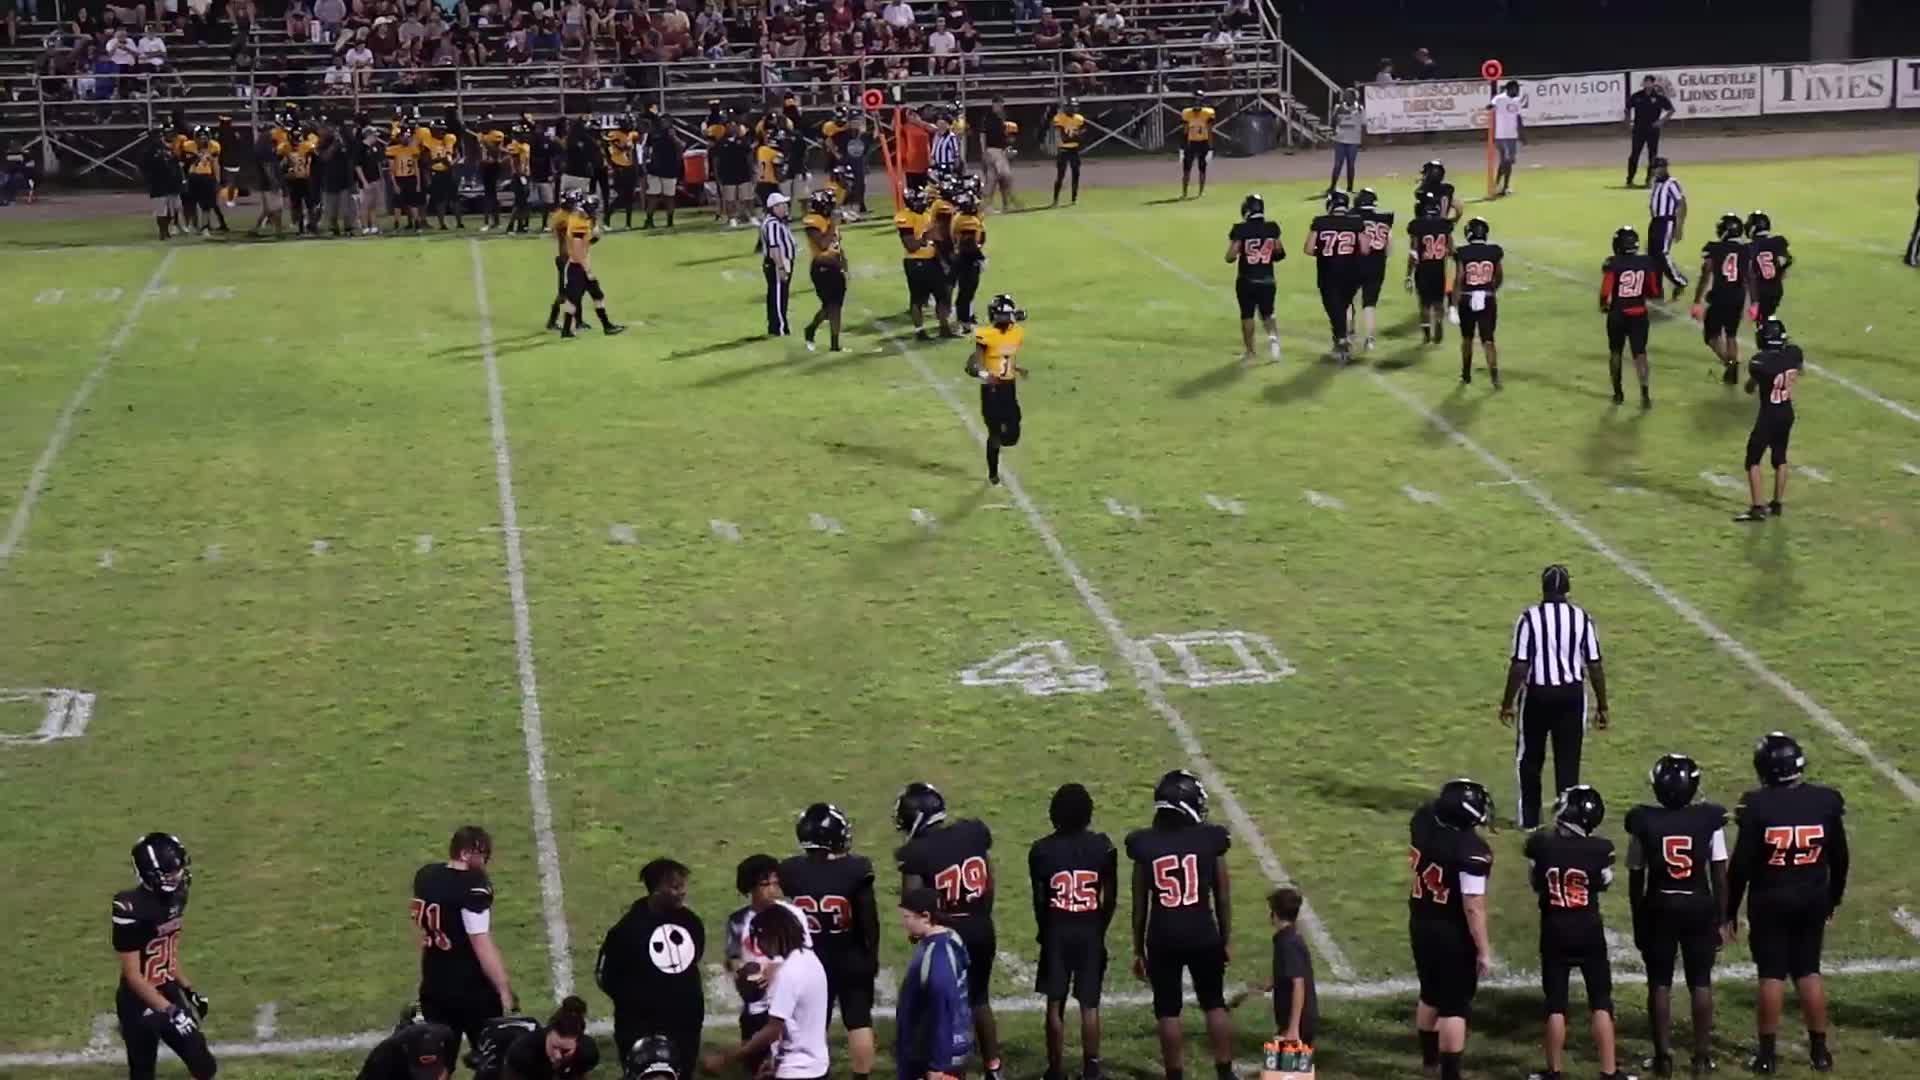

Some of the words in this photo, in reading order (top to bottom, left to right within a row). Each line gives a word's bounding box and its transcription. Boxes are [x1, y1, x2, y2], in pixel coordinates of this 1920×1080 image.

[1536, 79, 1621, 97] envision
[1678, 72, 1758, 87] GRACEVILLE
[1679, 89, 1718, 102] LIONS
[1721, 86, 1756, 100] CLUB
[1771, 66, 1884, 102] TIMES
[1244, 238, 1275, 264] 54
[1319, 230, 1356, 256] 72
[1618, 269, 1645, 298] 21
[1721, 252, 1738, 282] 4
[1662, 836, 1693, 880] 5
[1764, 824, 1825, 866] 75
[935, 855, 989, 910] 79
[1049, 869, 1099, 913] 35
[1152, 853, 1199, 908] 51
[1545, 866, 1590, 908] 16
